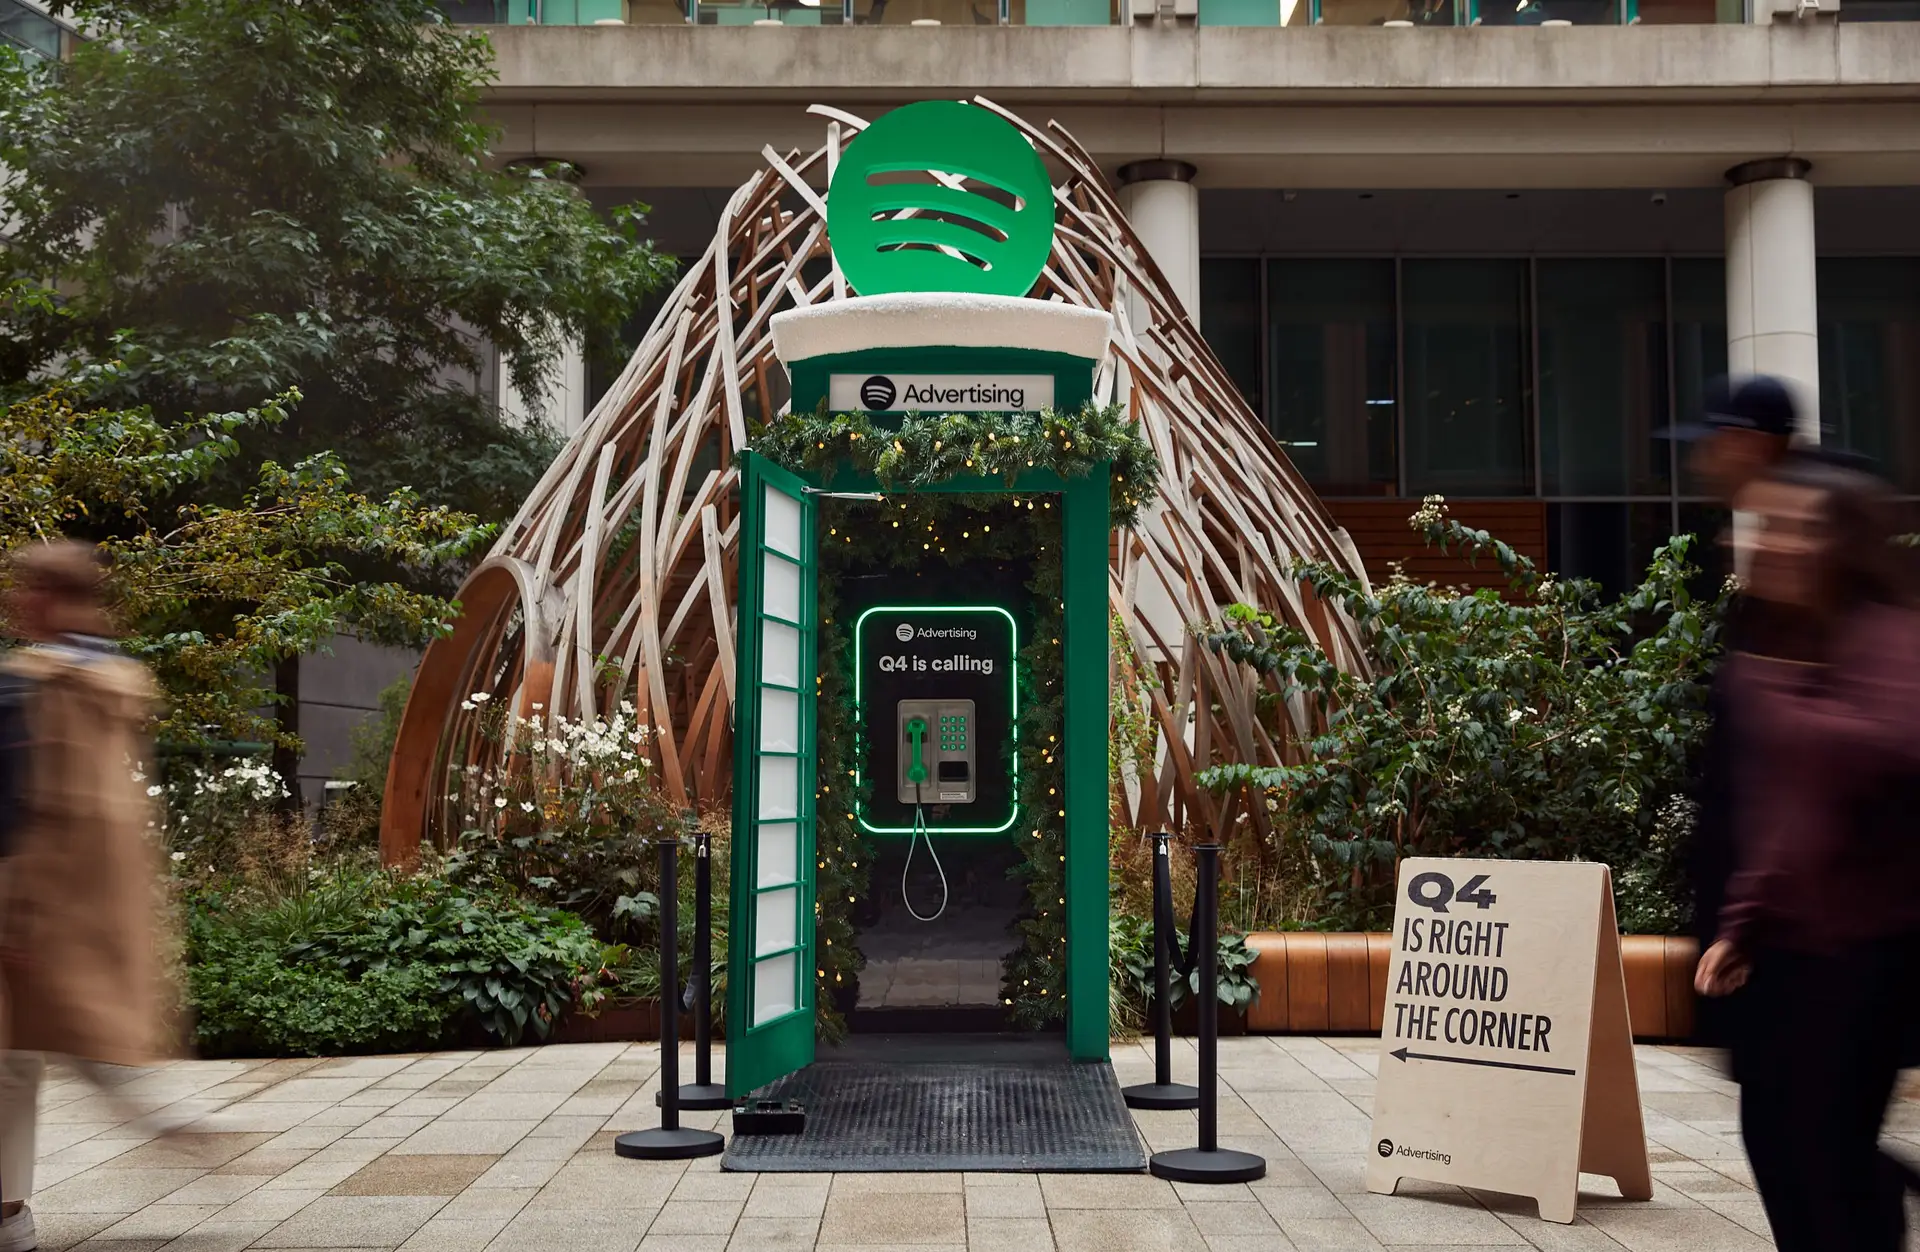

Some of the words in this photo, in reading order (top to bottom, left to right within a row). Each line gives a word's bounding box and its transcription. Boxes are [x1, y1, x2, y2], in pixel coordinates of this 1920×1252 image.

[903, 383, 1024, 406] Advertising
[917, 627, 977, 640] Advertising
[879, 656, 908, 673] Q4
[912, 655, 927, 672] is
[931, 654, 994, 675] calling
[1407, 871, 1497, 914] Q4
[1401, 917, 1425, 952] IS
[1428, 919, 1510, 958] RIGHT
[1396, 960, 1509, 1002] AROUND
[1394, 1003, 1438, 1041] THE
[1444, 1007, 1552, 1053] CORNER
[1396, 1145, 1452, 1165] Advertising
